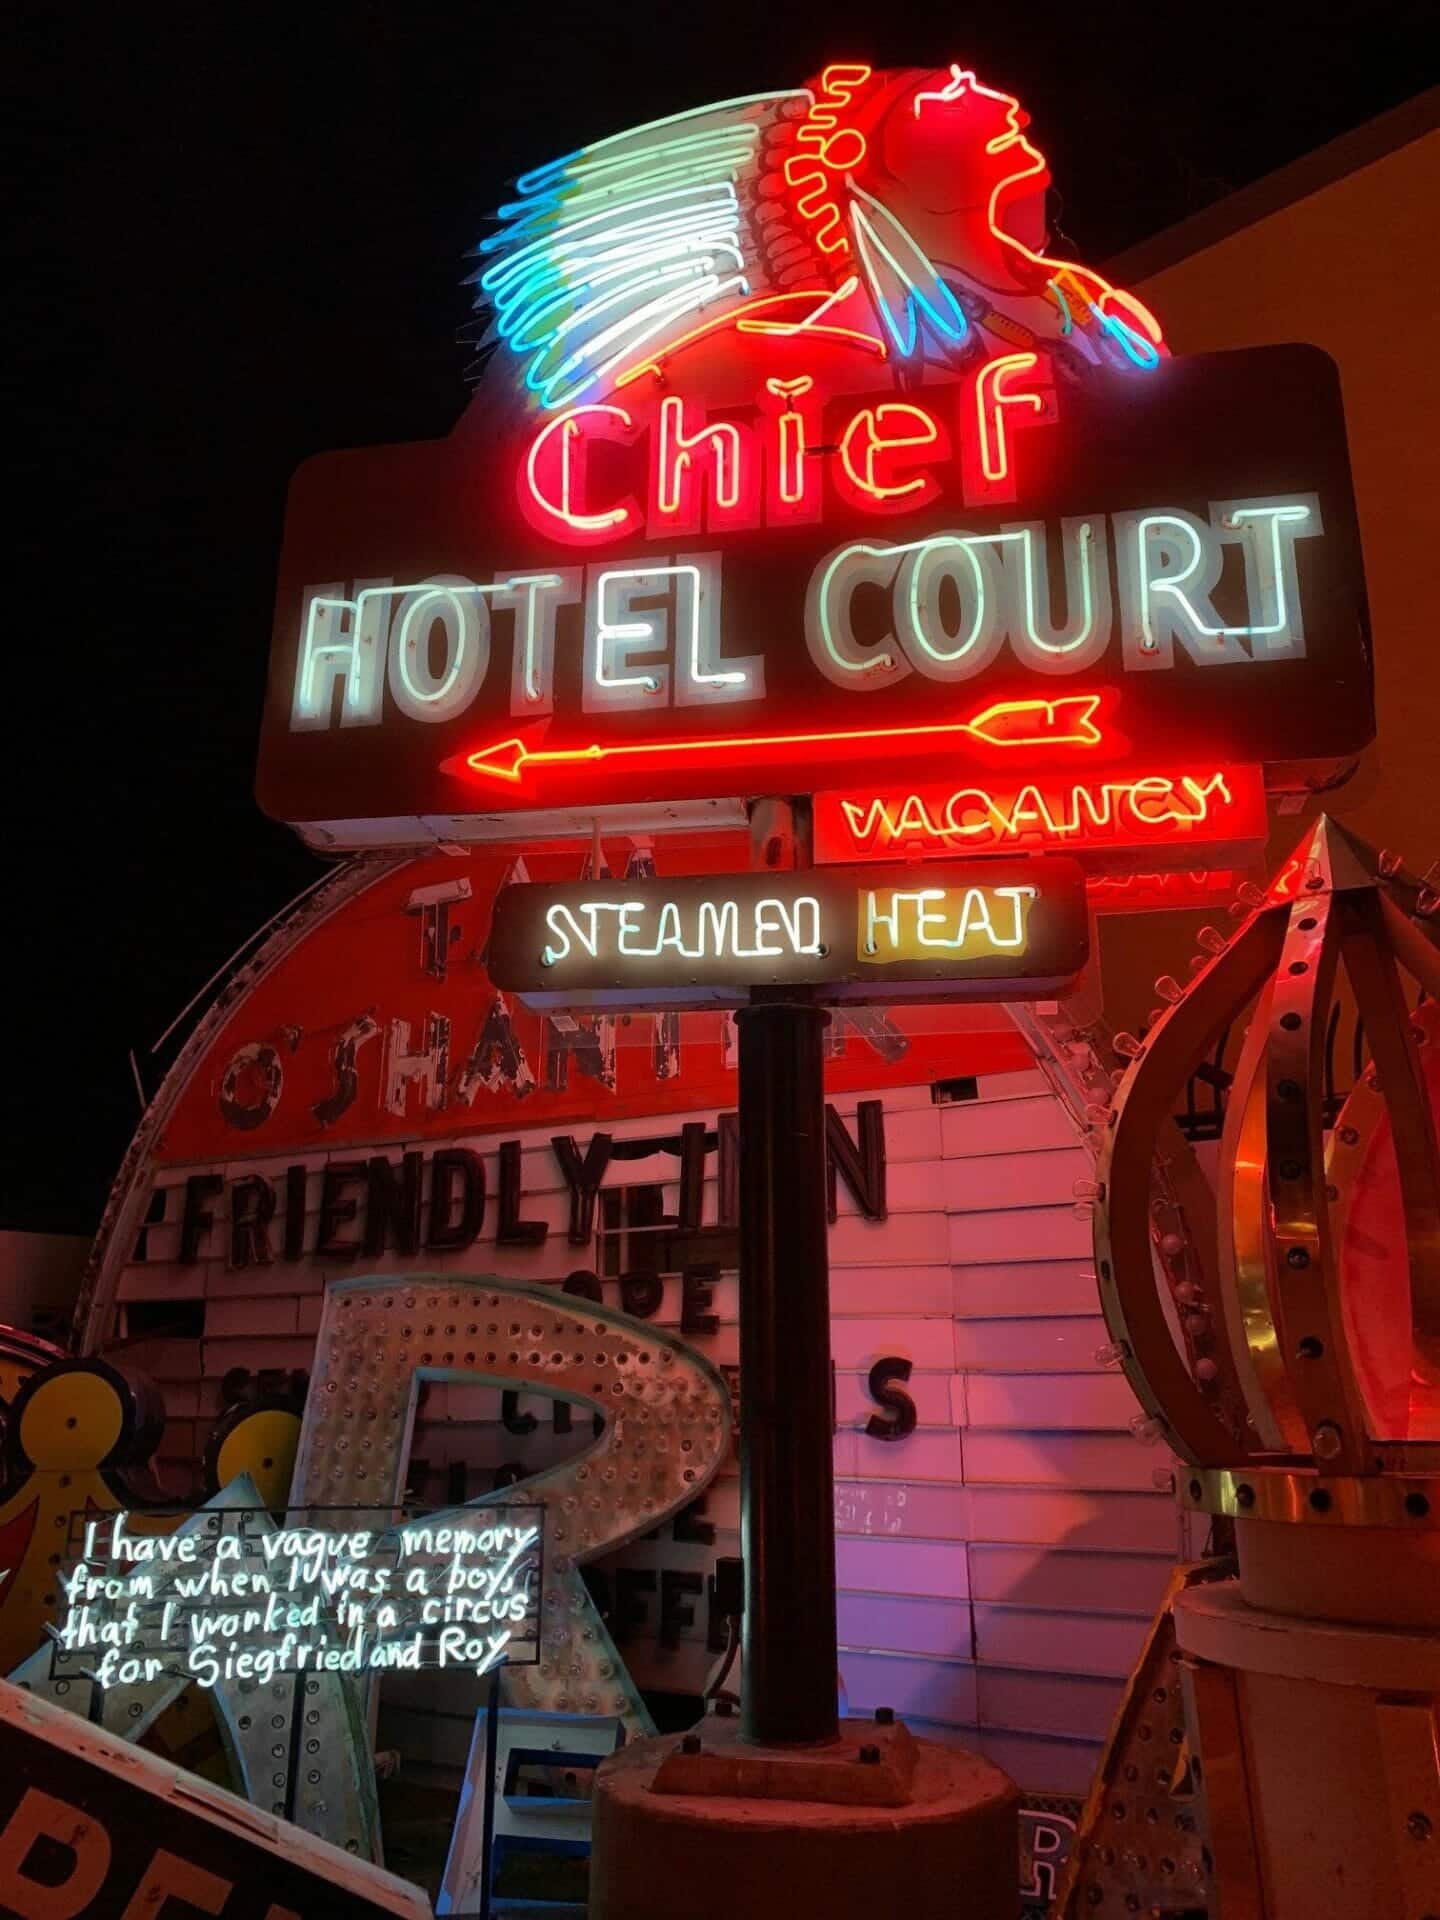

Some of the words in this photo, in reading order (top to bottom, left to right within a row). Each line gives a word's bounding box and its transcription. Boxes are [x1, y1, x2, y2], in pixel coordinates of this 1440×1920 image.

[518, 347, 1058, 545] Chief
[290, 550, 767, 732] HOTEL
[804, 492, 1324, 691] COURT
[841, 773, 1232, 852] VACANCY
[541, 897, 830, 967] STEAMED
[868, 889, 1038, 952] HEAT
[178, 1133, 612, 1271] FRIENDLY
[65, 1564, 154, 1604] from
[175, 1557, 270, 1597] when
[288, 1557, 298, 1592] I
[322, 1566, 391, 1594] was
[406, 1569, 430, 1595] a
[84, 1522, 97, 1560] I
[111, 1511, 197, 1562] have
[216, 1536, 242, 1561] a
[262, 1531, 372, 1583] vague
[402, 1526, 537, 1560] memory
[61, 1603, 138, 1649] that
[160, 1602, 174, 1641] I
[191, 1592, 320, 1644] worked
[336, 1591, 364, 1628] in
[377, 1605, 396, 1628] a
[422, 1594, 529, 1624] circus
[97, 1649, 163, 1689] for
[189, 1624, 364, 1687] Siegfried
[370, 1632, 422, 1669] and
[438, 1627, 512, 1677] Roy
